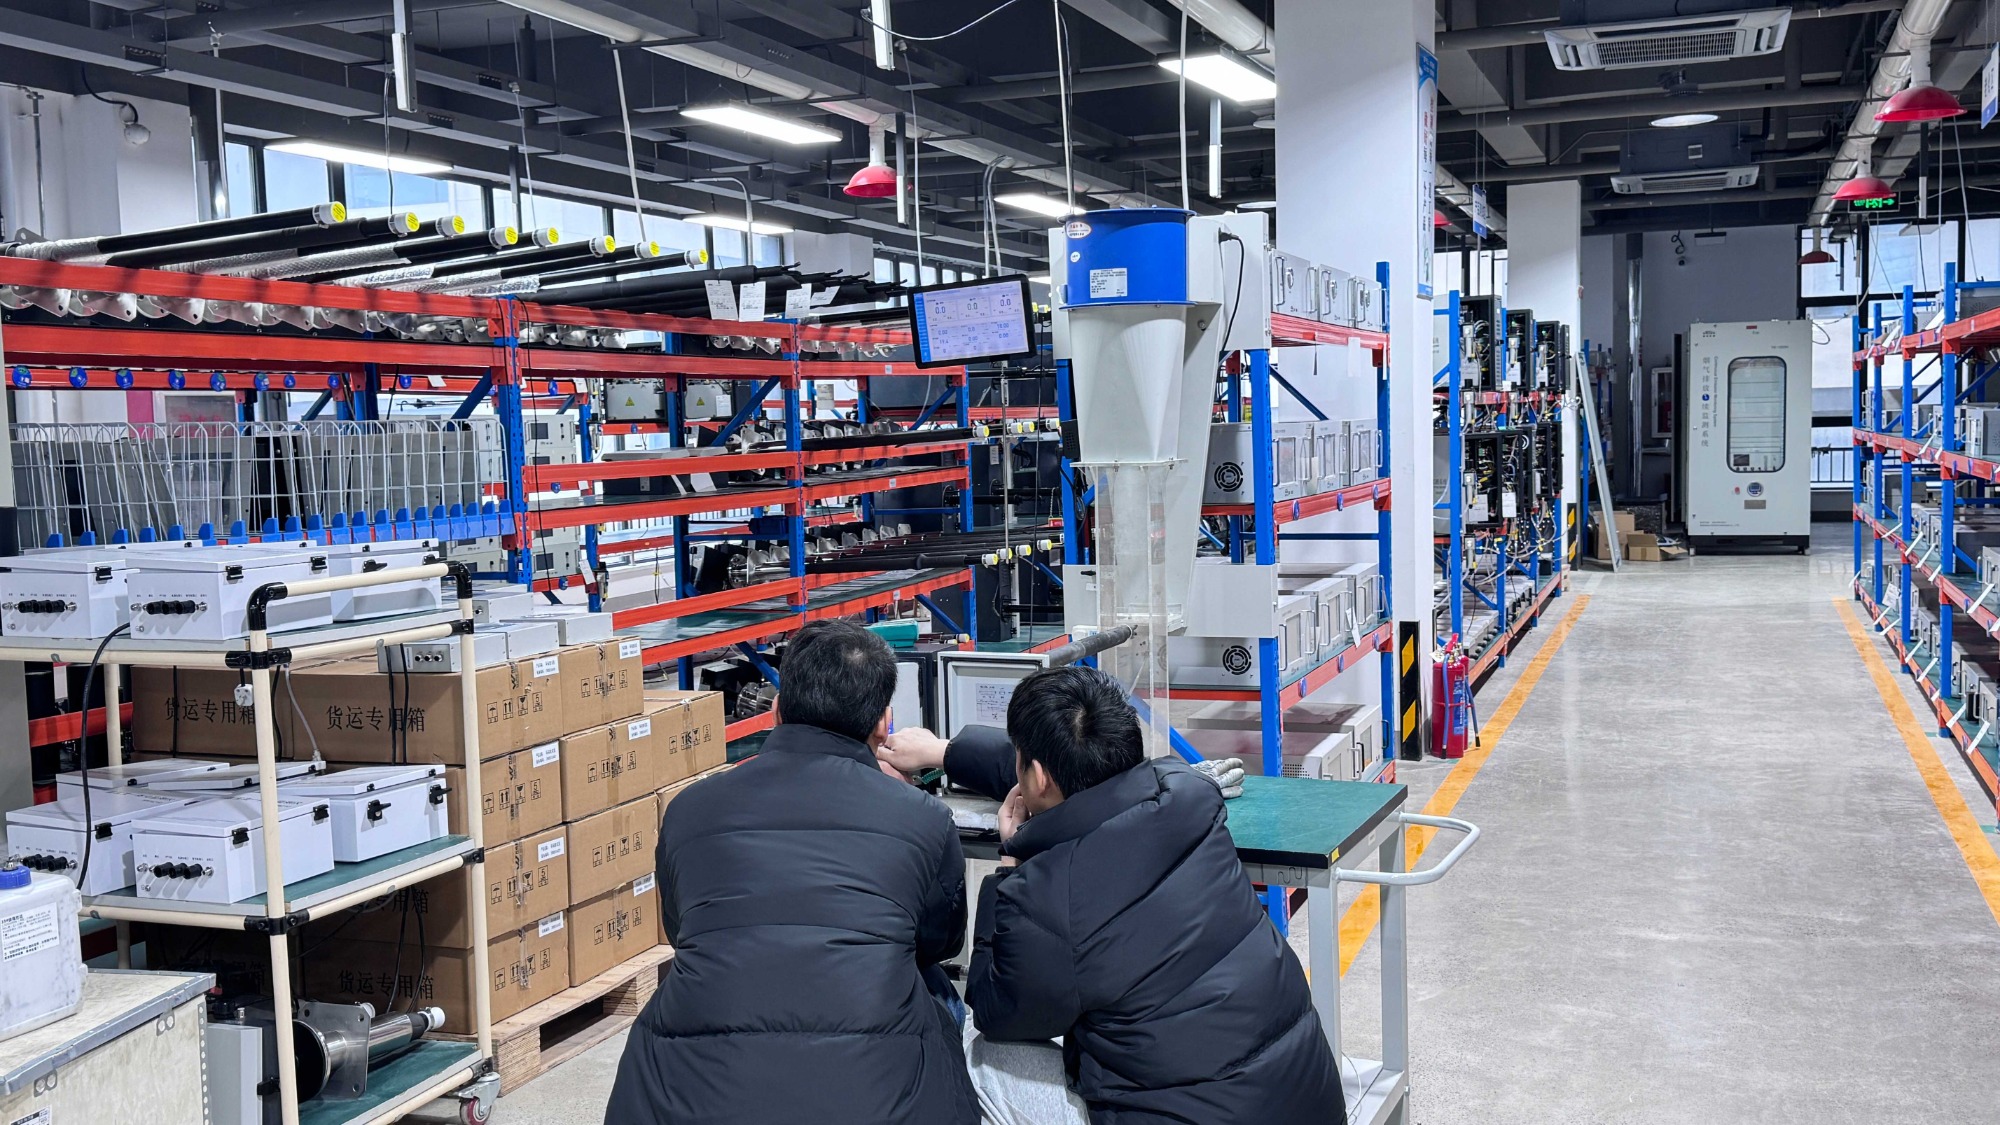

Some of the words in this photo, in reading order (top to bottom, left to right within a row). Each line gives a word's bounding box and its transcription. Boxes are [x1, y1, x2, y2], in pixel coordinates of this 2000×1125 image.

[967, 302, 978, 311] 0.0
[1000, 298, 1012, 307] 0.0
[935, 305, 946, 315] 0.0
[326, 705, 426, 733] 货运专用箱
[337, 970, 434, 1000] 货运专用箱
